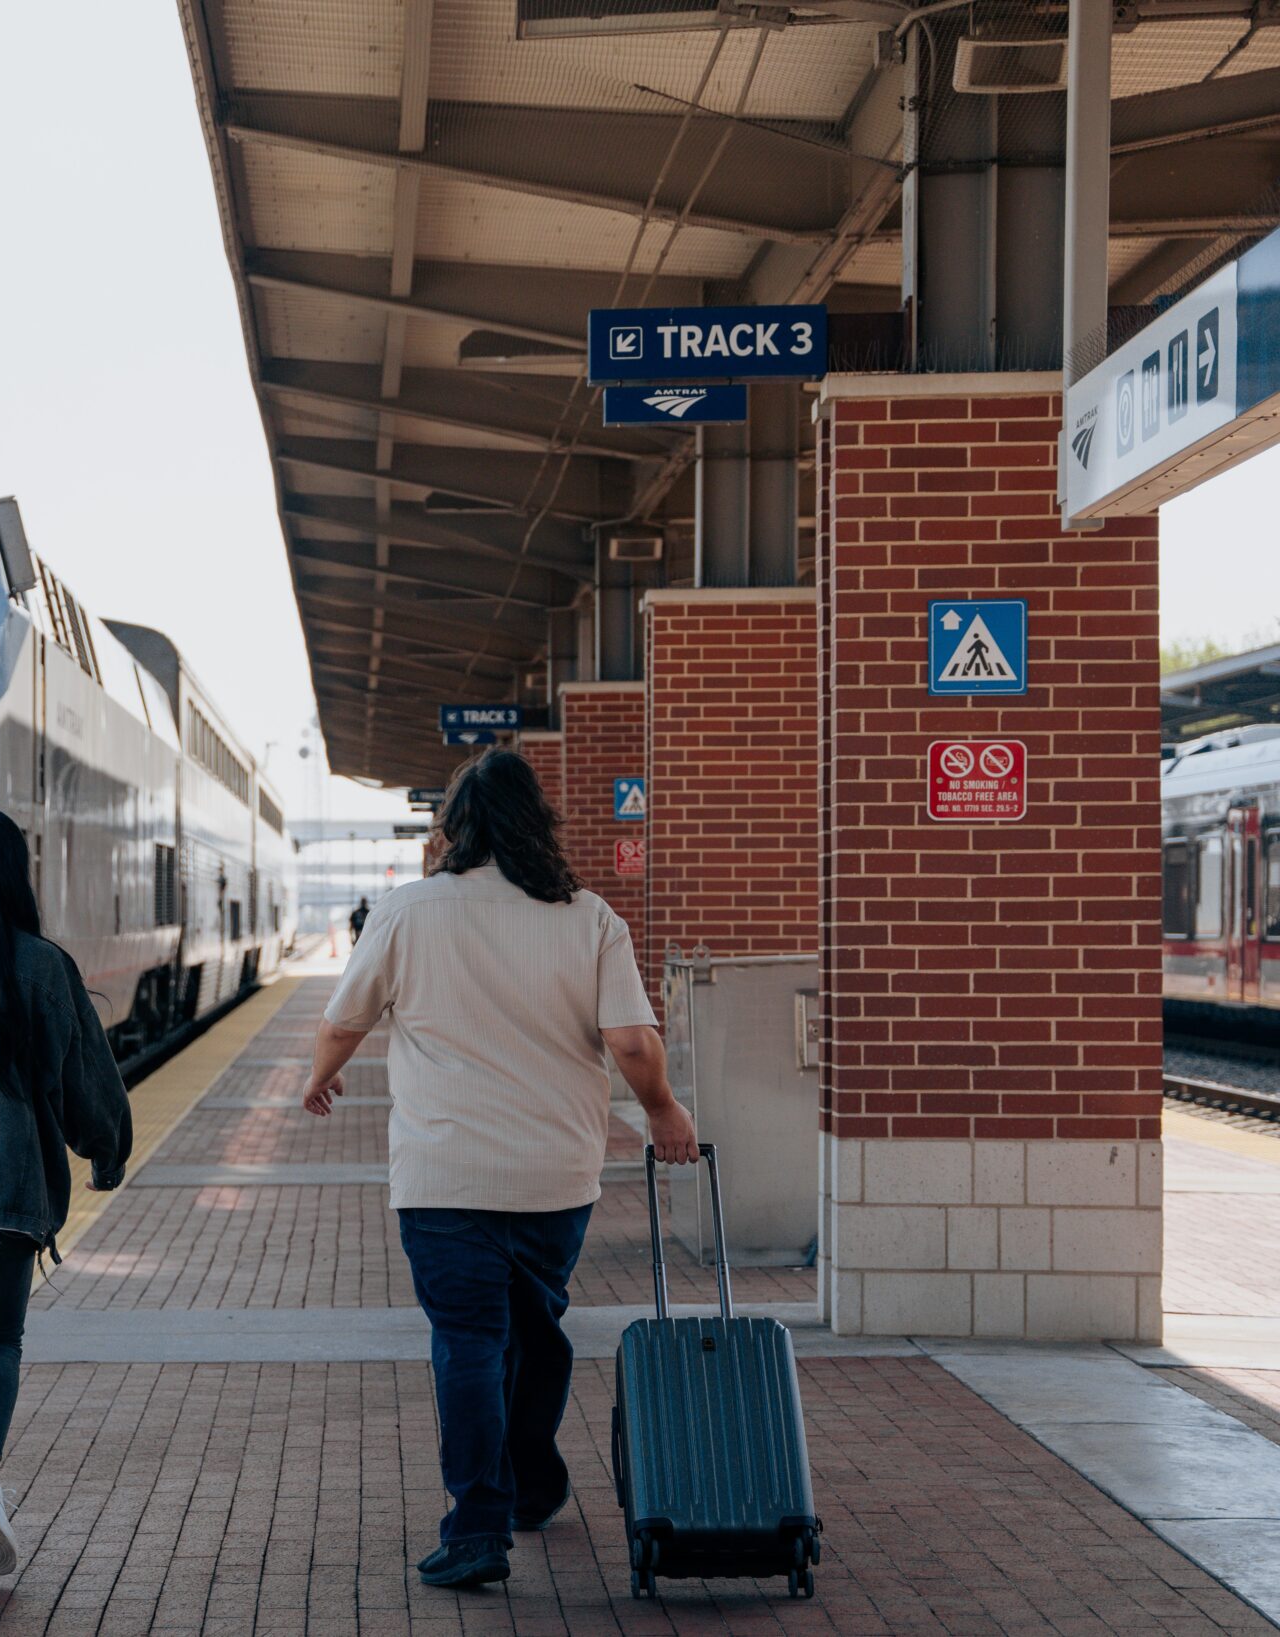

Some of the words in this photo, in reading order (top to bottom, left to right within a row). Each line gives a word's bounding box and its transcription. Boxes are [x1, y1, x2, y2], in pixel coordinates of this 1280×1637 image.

[657, 323, 780, 358] TRACK
[789, 321, 813, 356] 3
[1075, 404, 1098, 429] AMTRAK
[463, 710, 506, 724] TRACK
[508, 710, 518, 724] 3
[949, 780, 960, 790] NO
[963, 780, 999, 790] SMOKING
[937, 791, 973, 801] TOBACCO
[975, 791, 994, 801] FREE
[997, 791, 1018, 801] AREA
